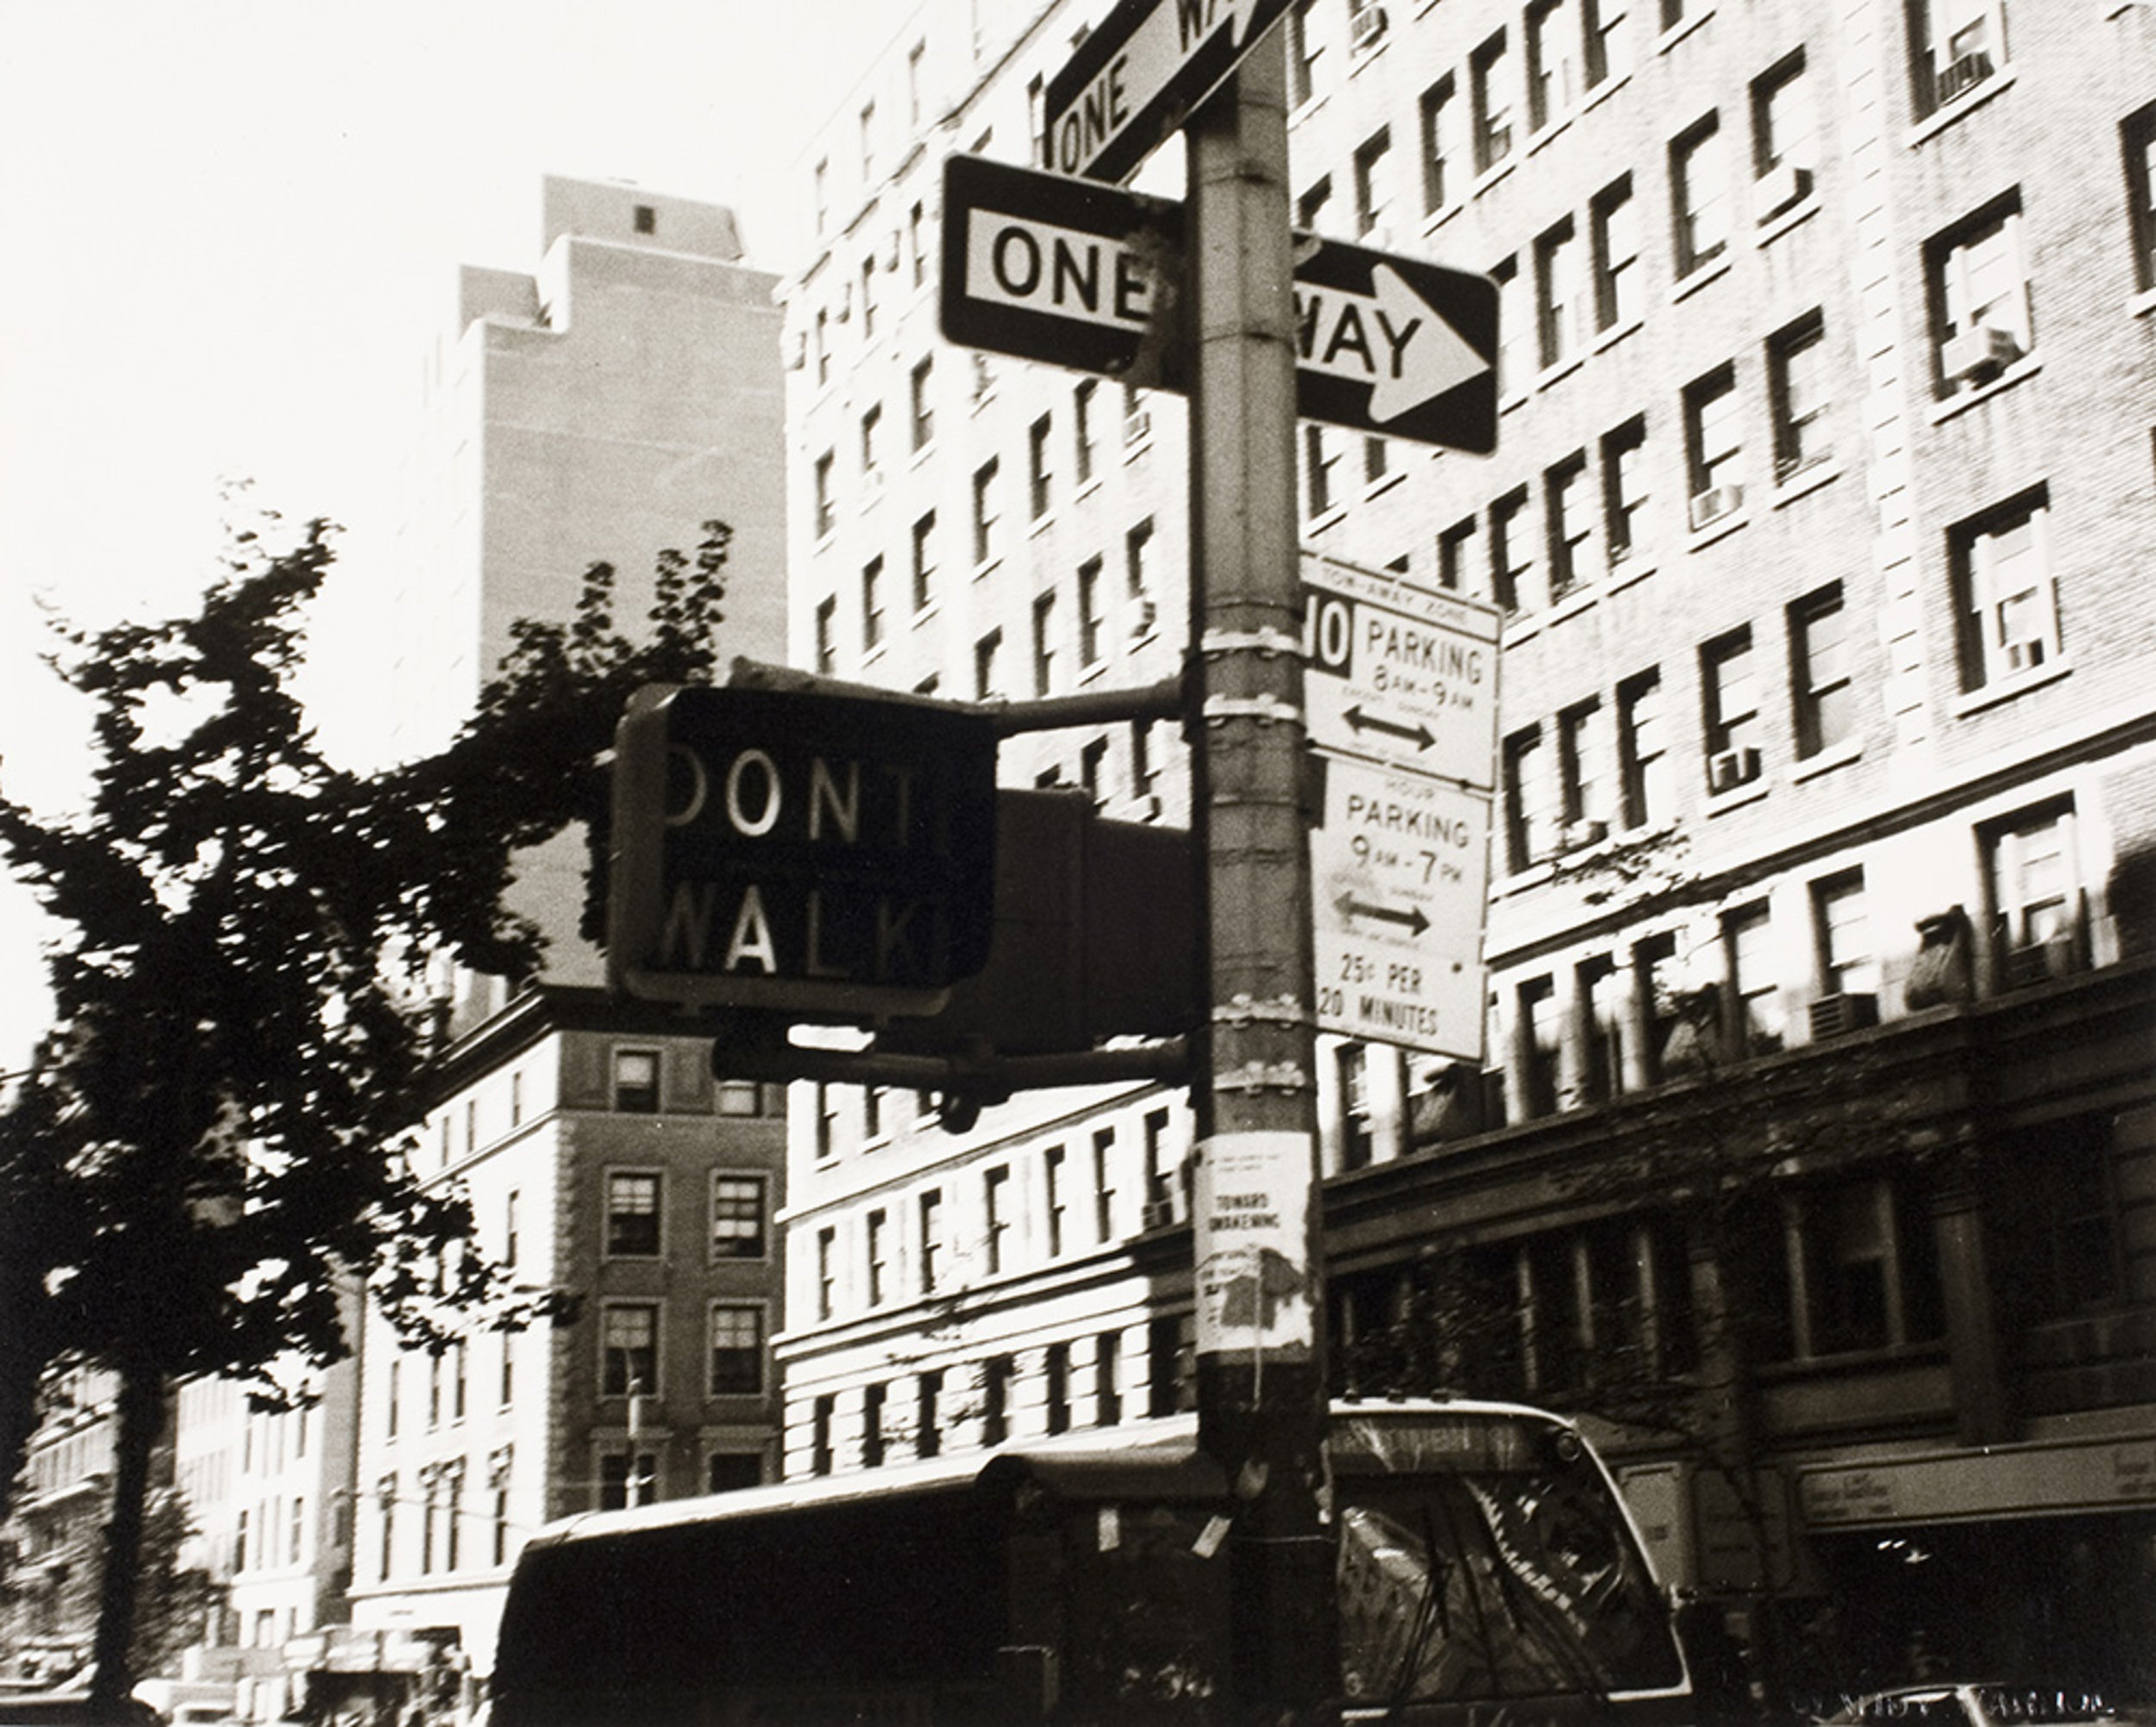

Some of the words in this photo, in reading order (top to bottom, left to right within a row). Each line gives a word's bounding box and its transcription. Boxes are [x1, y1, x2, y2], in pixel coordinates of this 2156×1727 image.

[1062, 53, 1129, 174] ONE
[992, 225, 1154, 323] ONE
[1366, 619, 1482, 686] PARKING
[665, 741, 924, 848] DONT
[1346, 793, 1470, 849] PARKING
[661, 883, 918, 980] WALK
[1318, 986, 1344, 1017] 20
[1357, 995, 1438, 1037] MINUTES
[1386, 962, 1422, 996] PER
